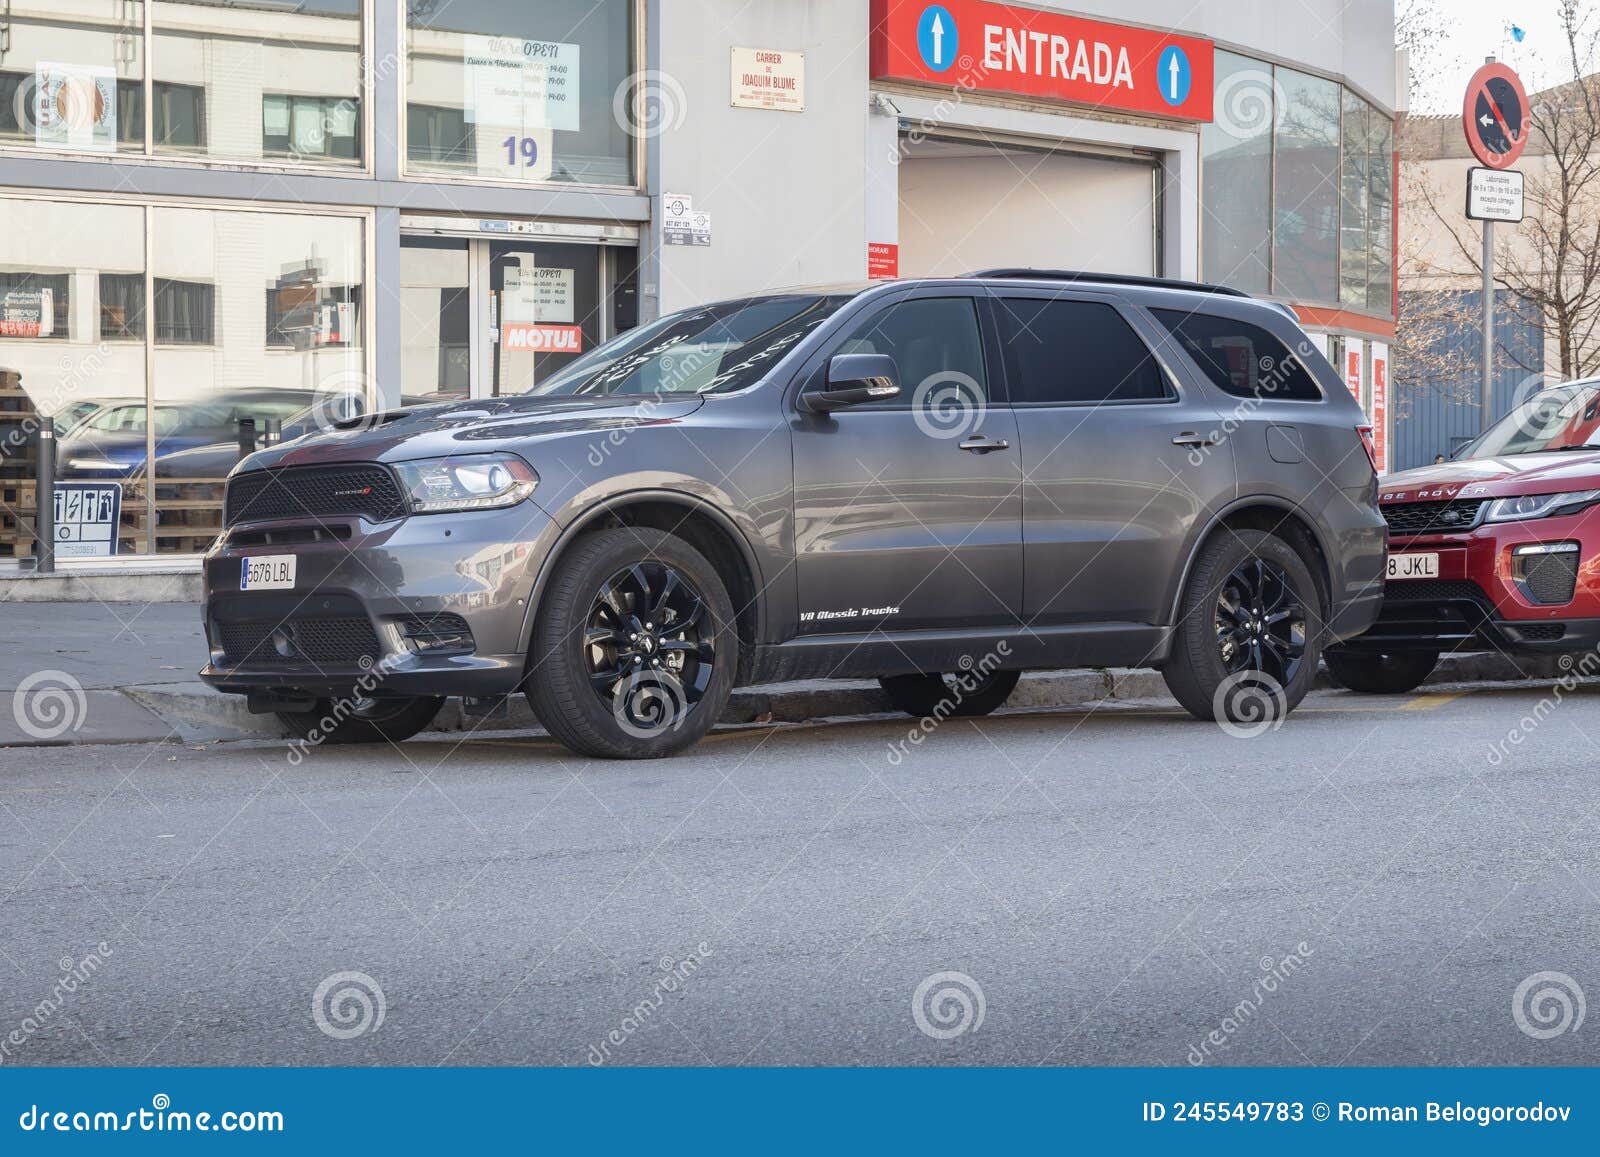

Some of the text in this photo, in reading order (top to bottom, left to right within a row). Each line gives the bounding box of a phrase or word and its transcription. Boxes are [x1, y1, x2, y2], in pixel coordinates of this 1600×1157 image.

[523, 42, 559, 58] OPEN
[755, 51, 782, 64] CARRER
[984, 23, 1135, 90] ENTRADA
[741, 73, 796, 90] JOAQUIM BLUME
[503, 136, 537, 167] 19
[507, 328, 579, 349] MOTUL
[1418, 486, 1488, 498] ROVER
[248, 563, 293, 582] 5676 LBL
[1403, 556, 1434, 575] JKL
[800, 606, 900, 621] V8 Classic Trucks
